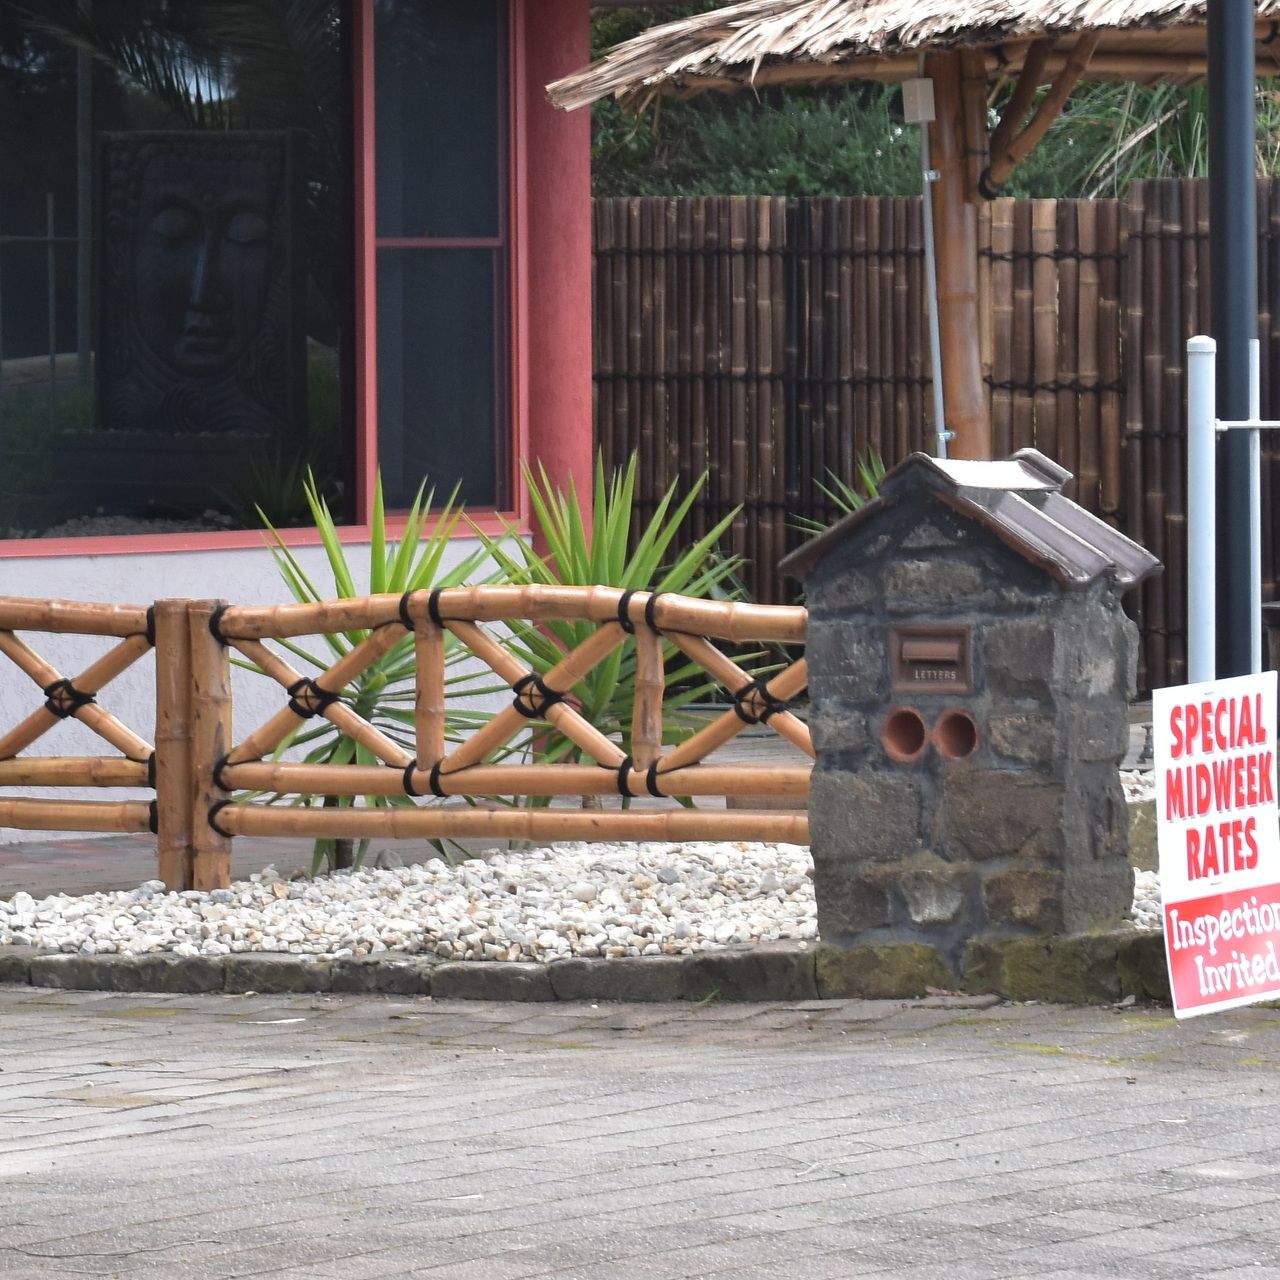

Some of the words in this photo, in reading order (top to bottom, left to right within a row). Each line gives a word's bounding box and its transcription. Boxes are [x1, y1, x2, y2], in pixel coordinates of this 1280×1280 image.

[914, 669, 957, 681] LETTERS
[1169, 693, 1268, 760] SPECIAL
[1166, 751, 1274, 822] MIDWEEK
[1186, 817, 1260, 881] RATES
